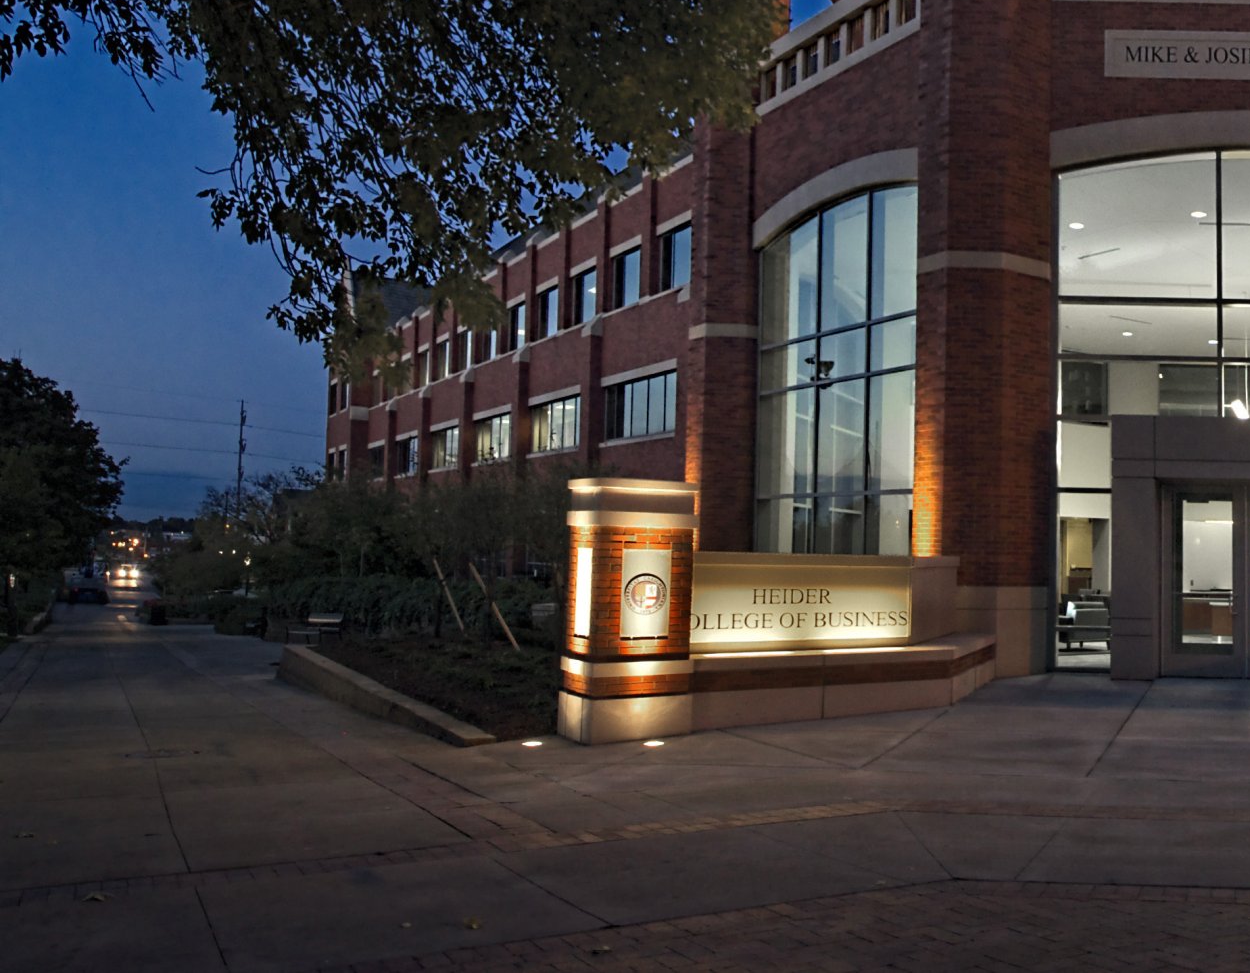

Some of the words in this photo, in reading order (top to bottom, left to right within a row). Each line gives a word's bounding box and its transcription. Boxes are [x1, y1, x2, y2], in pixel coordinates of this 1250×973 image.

[1125, 45, 1178, 64] MIKE
[1183, 46, 1200, 64] &
[753, 588, 832, 605] HEIDER
[690, 612, 774, 630] OLLEGE
[779, 611, 808, 628] OF
[814, 610, 908, 628] BUSINESS
